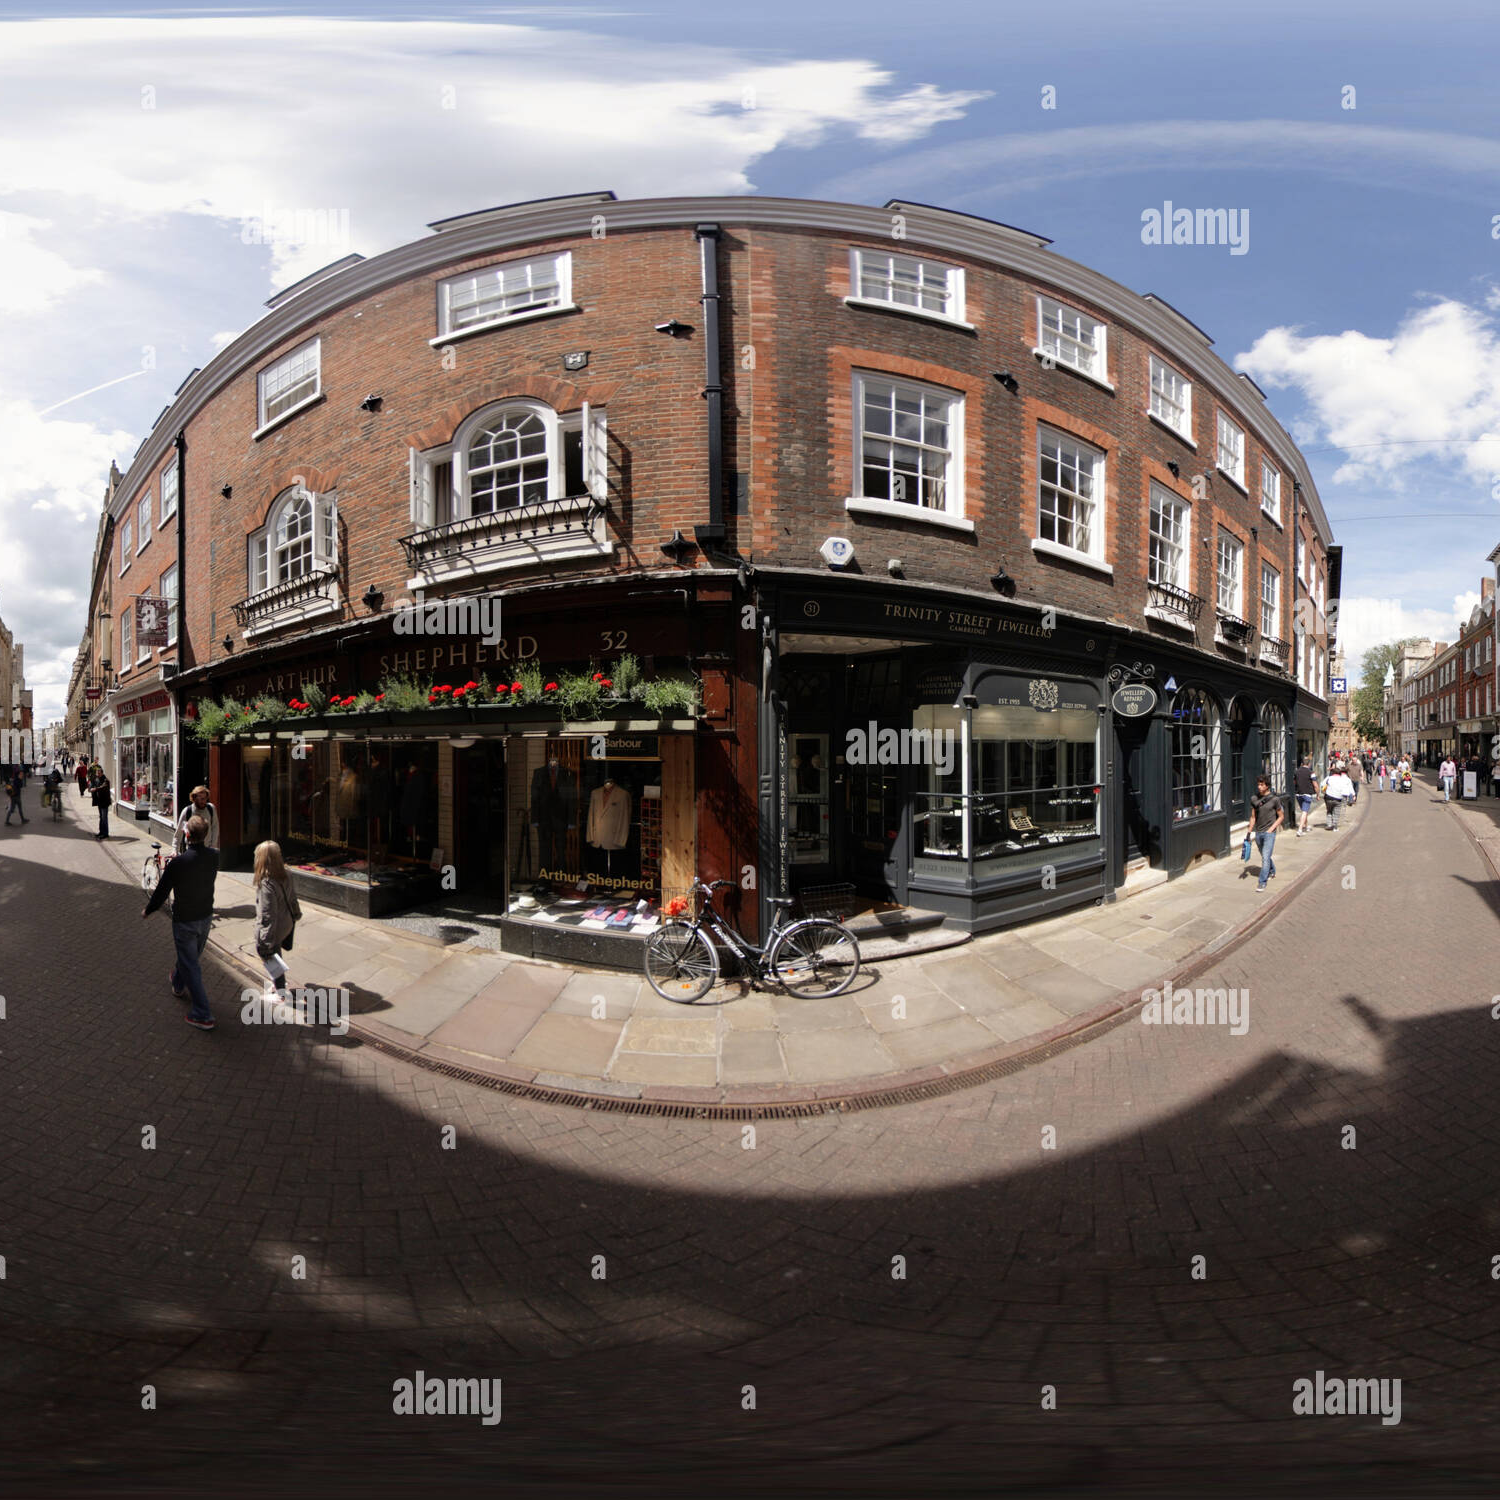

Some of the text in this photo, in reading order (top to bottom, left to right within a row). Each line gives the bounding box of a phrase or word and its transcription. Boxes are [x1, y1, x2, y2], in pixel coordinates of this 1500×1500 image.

[884, 603, 1053, 640] TRINITY STREET JEWELLERS
[949, 625, 989, 636] CAMBRIDGE
[265, 664, 338, 694] ARTHUR
[379, 635, 539, 676] SHEPHERD
[600, 630, 629, 652] 32
[1120, 689, 1147, 698] JEWELLERY
[603, 737, 643, 748] Barbour
[538, 867, 655, 890] Arthur Shepherd
